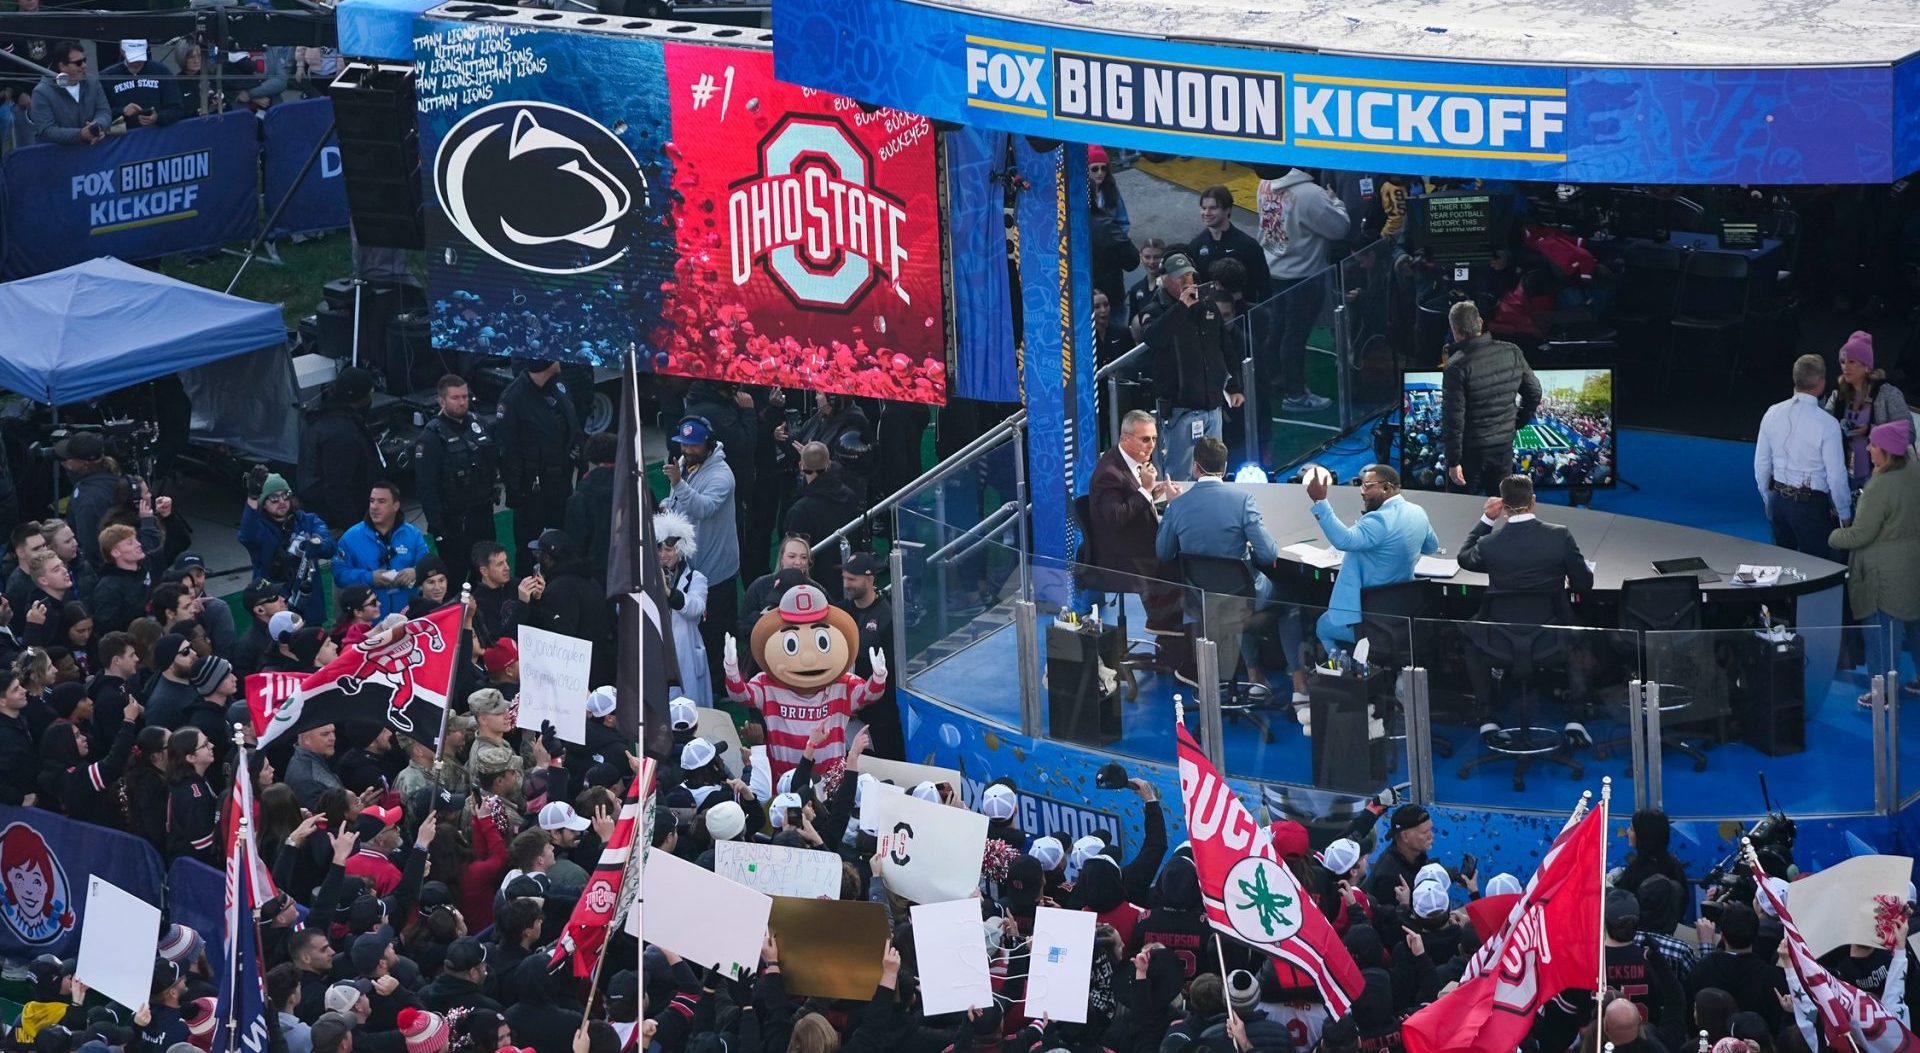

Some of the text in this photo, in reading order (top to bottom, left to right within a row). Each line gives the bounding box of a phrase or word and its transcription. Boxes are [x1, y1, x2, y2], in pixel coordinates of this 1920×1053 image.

[435, 37, 512, 60] NITTANY LIONS
[517, 58, 548, 77] LIONS
[114, 79, 159, 93] PENN STATE
[691, 66, 735, 122] #1
[967, 46, 1567, 148] FOX BIG NOON KICKOFF
[418, 84, 494, 113] NITTANY LIONS
[879, 119, 928, 161] BUCKEYES
[72, 151, 209, 200] FOX BIG NOON
[90, 185, 199, 226] KICKOFF
[1449, 210, 1484, 219] FOOTBALL
[728, 181, 801, 285] OHIO
[804, 167, 911, 305] STATE
[1457, 269, 1463, 277] 3
[780, 704, 828, 719] BRUTUS
[719, 842, 773, 862] PENN
[1607, 964, 1644, 980] CKSON
